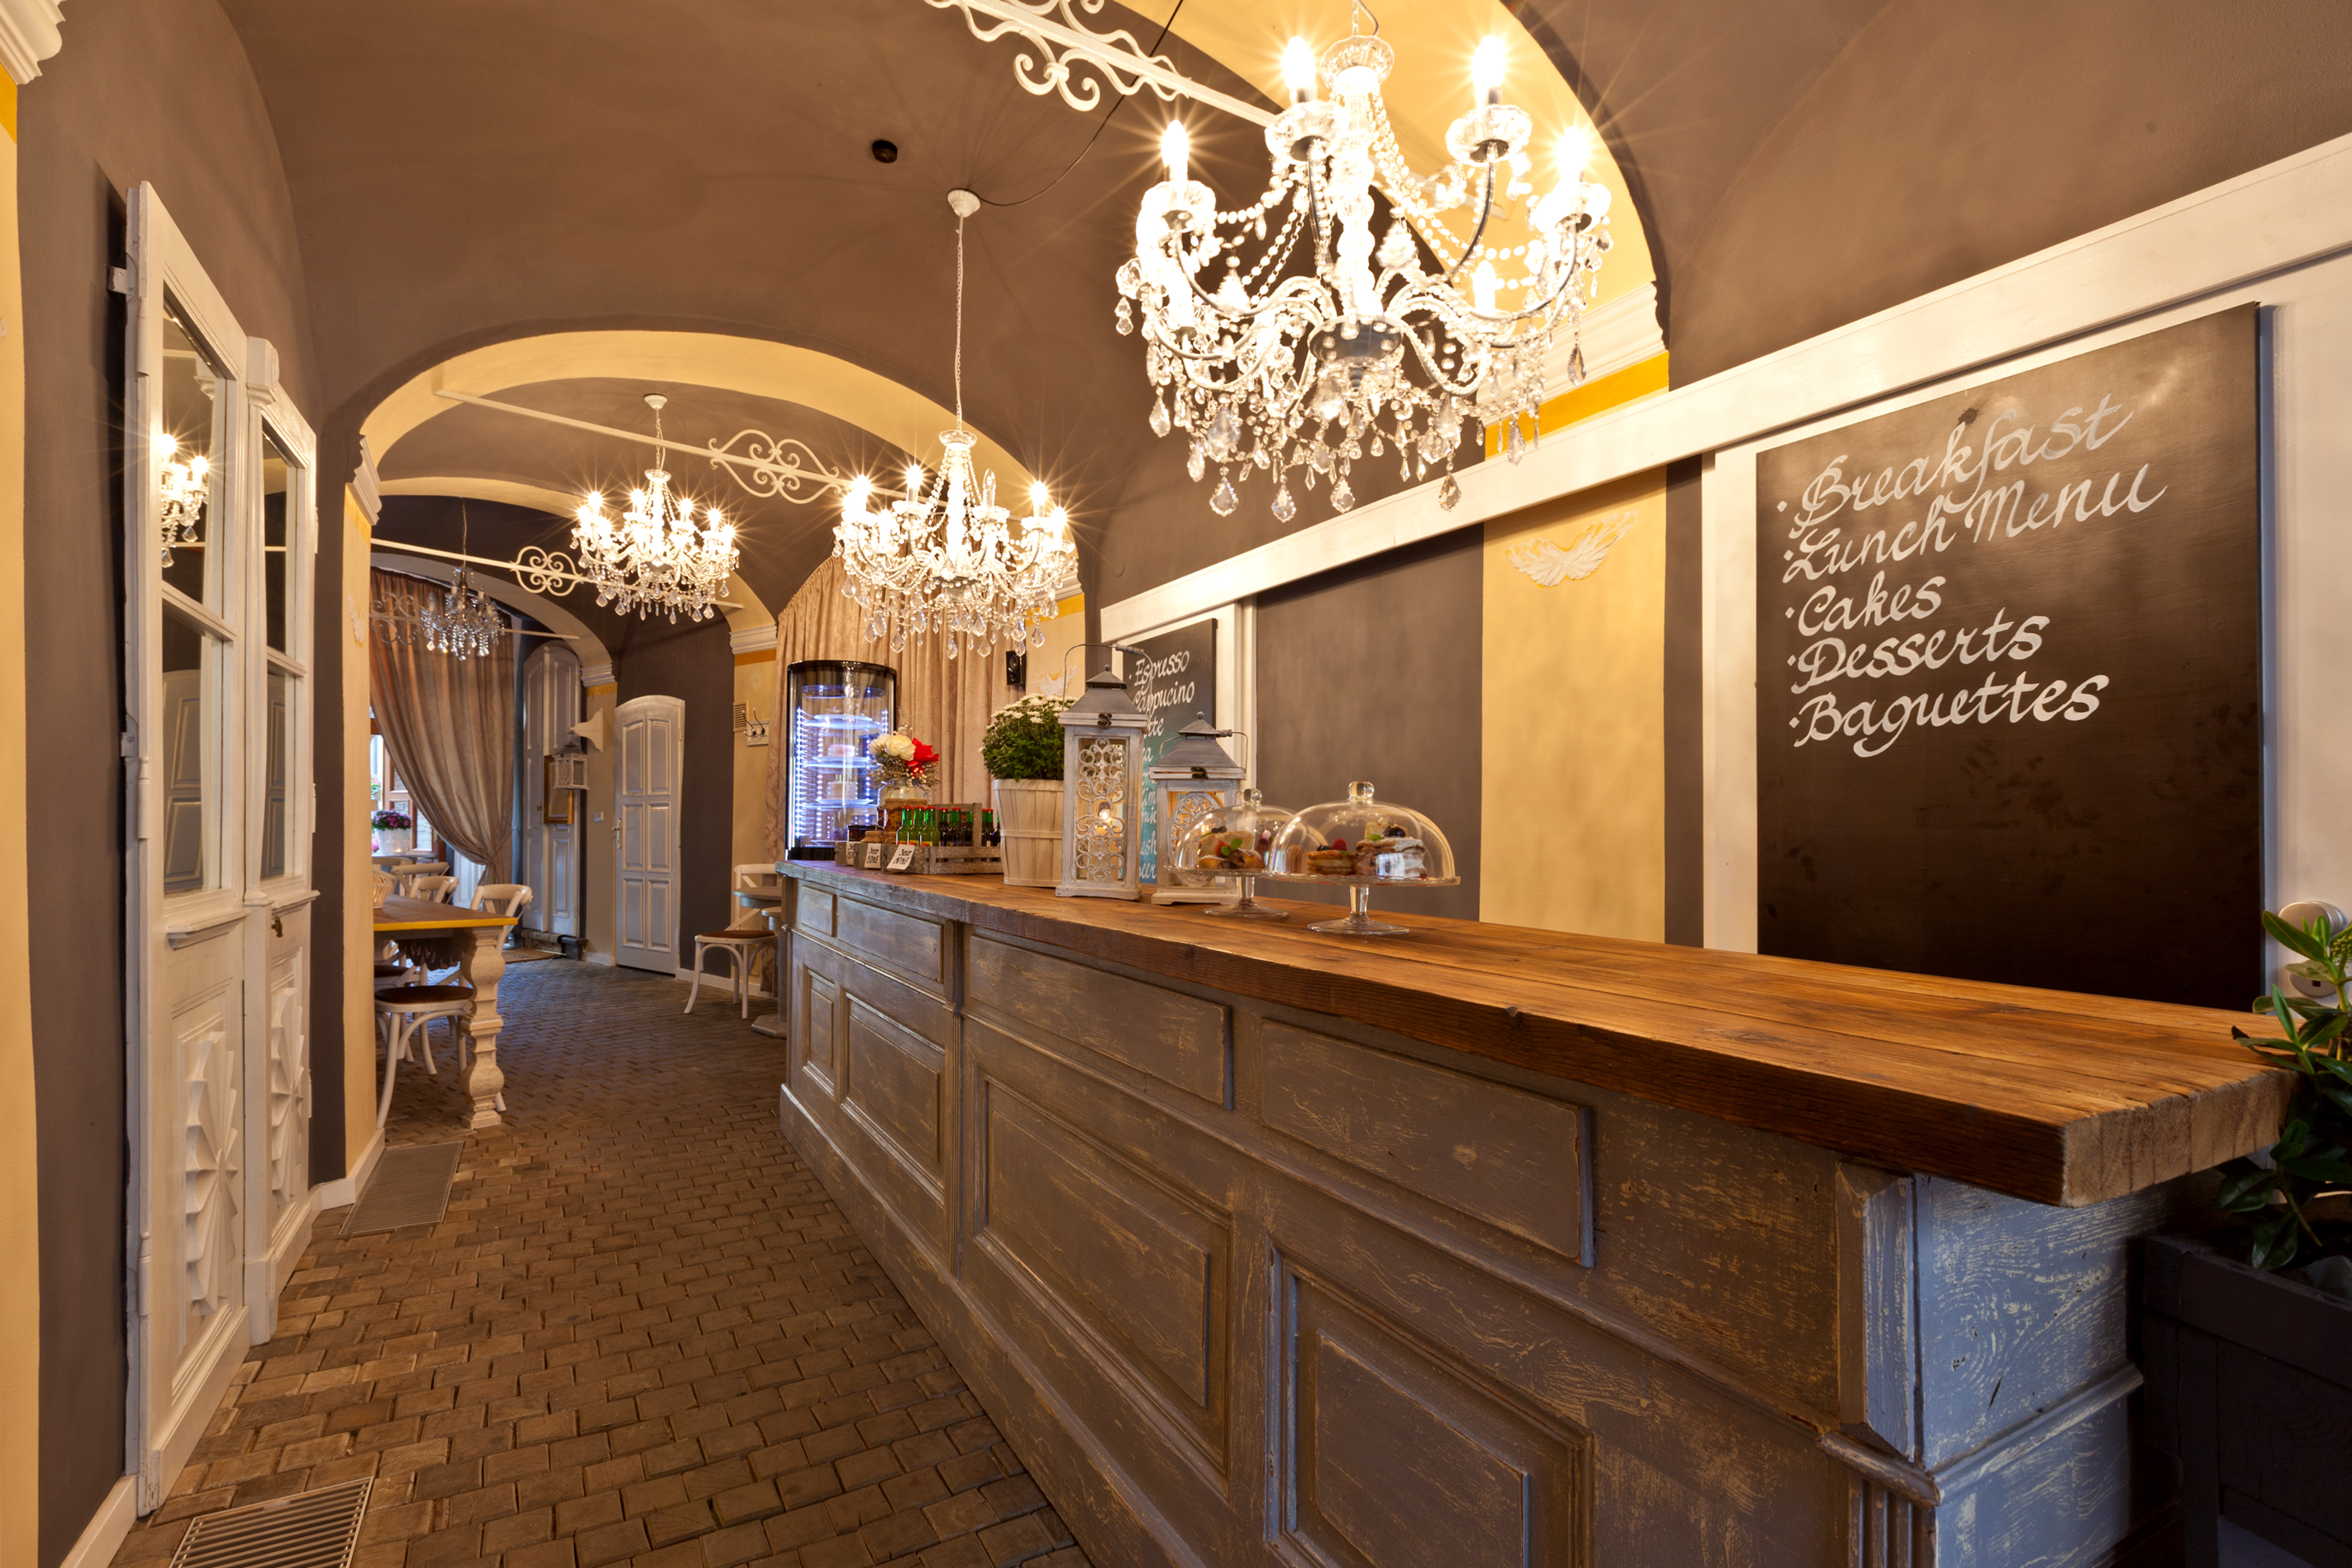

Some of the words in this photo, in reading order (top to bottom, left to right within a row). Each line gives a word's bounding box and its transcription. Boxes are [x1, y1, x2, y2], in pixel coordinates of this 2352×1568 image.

[1789, 392, 2134, 538] Breakfast
[1783, 495, 1957, 583] Lunch
[1966, 463, 2168, 543] Menu
[1798, 570, 1946, 636] Cakes
[1134, 651, 1190, 696] Espresso
[1791, 607, 2050, 694] Desserts
[1794, 671, 2110, 757] Baguettes
